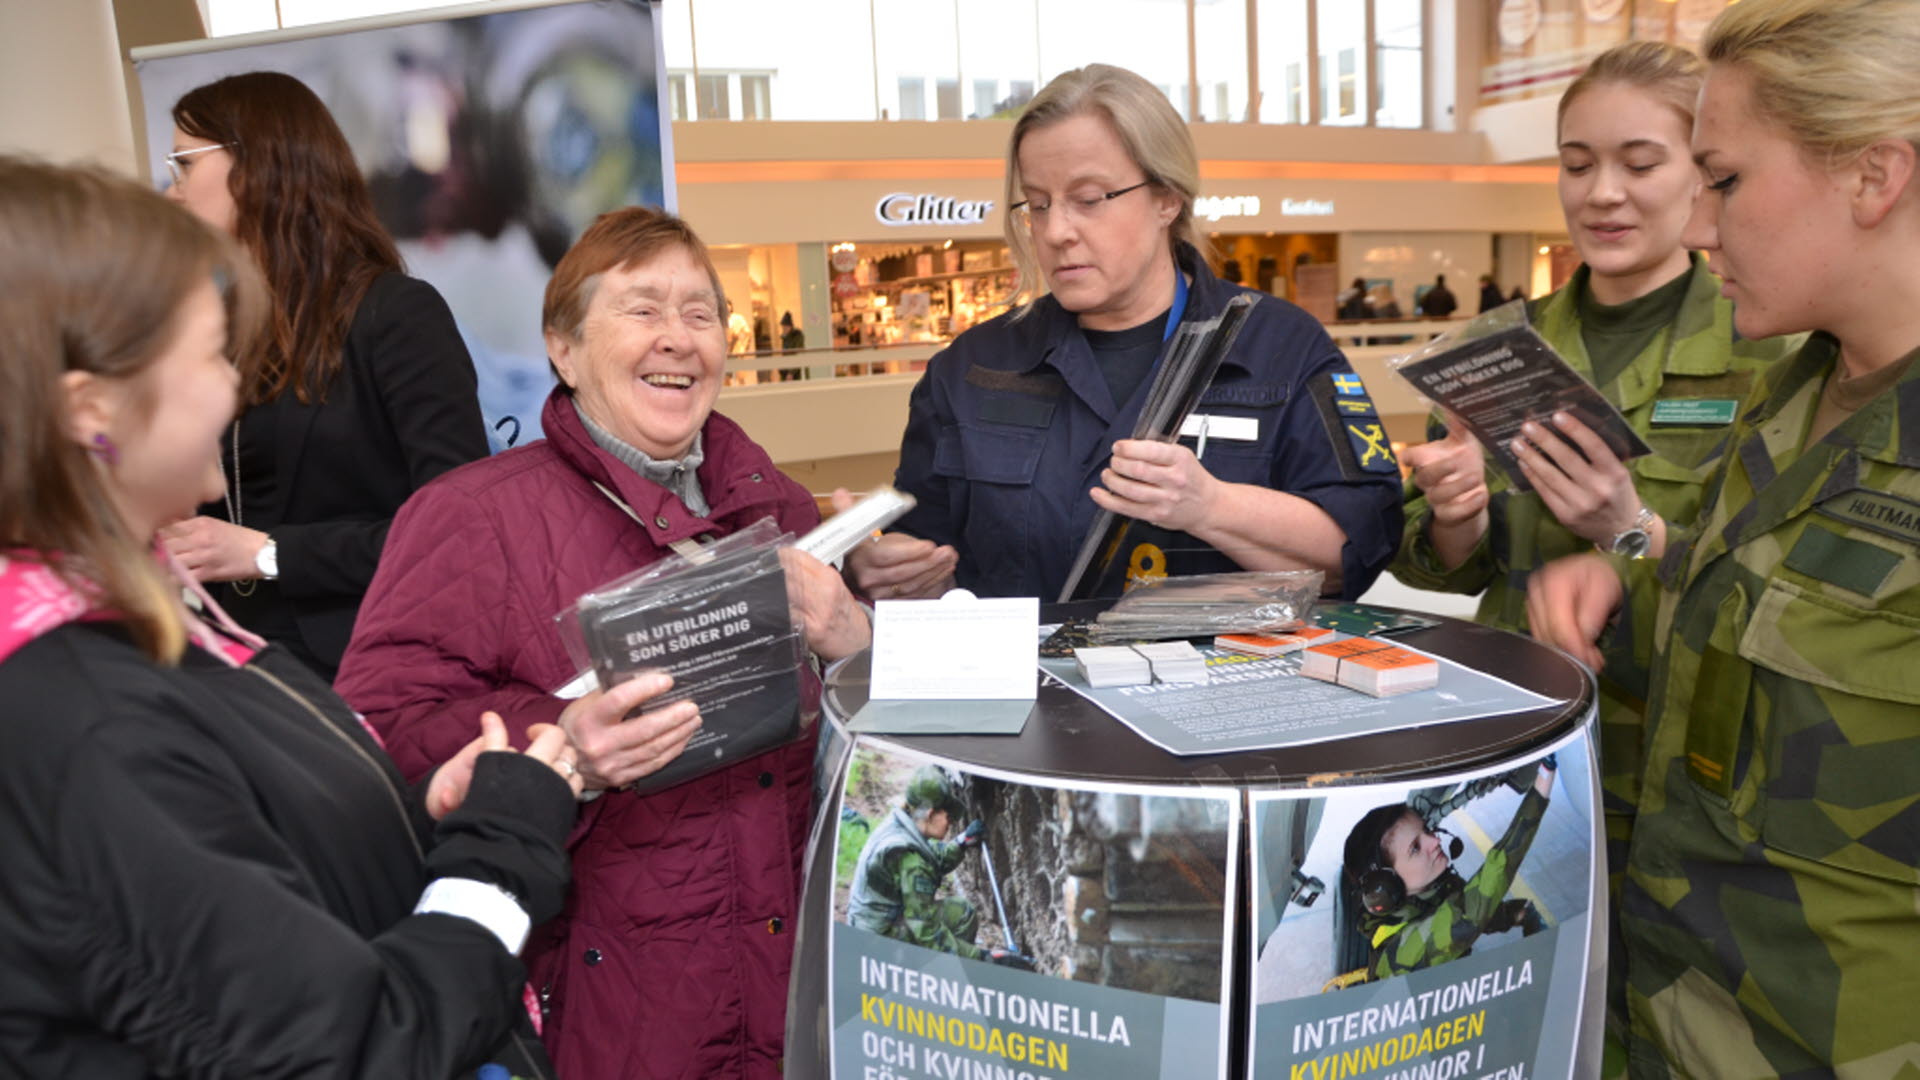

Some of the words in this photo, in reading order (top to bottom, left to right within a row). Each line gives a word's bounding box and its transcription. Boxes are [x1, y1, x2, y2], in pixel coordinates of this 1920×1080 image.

[875, 192, 994, 226] Glitter
[626, 629, 649, 646] EN
[651, 601, 748, 639] UTBILDNING
[629, 643, 666, 663] SOM
[669, 628, 721, 653] SÖKER
[723, 619, 750, 637] DIG
[860, 956, 1131, 1047] INTERNATIONELLA
[1292, 960, 1533, 1054] INTERNATIONELLA
[861, 993, 1069, 1072] KVINNODAGEN
[862, 1030, 916, 1070] OCH
[923, 1047, 1055, 1080] KVINN
[1289, 1010, 1486, 1080] KVINNODAGEN
[1476, 1043, 1486, 1070] I
